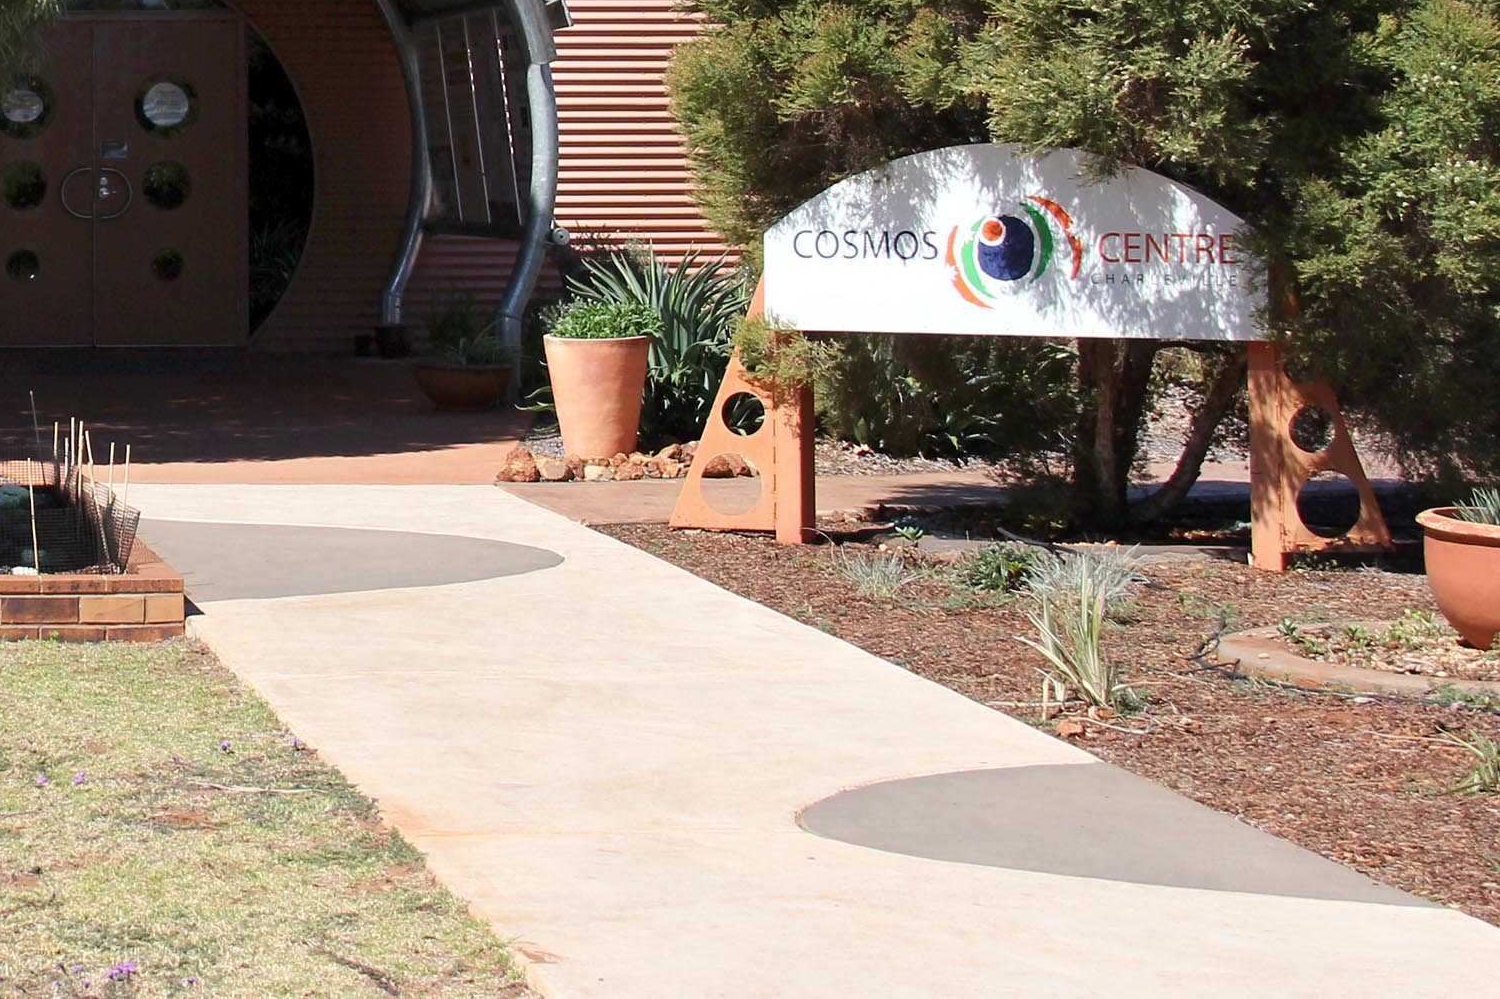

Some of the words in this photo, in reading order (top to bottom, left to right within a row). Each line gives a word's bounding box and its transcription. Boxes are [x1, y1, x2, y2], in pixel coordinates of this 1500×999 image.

[793, 230, 938, 260] COSMOS
[1099, 232, 1238, 264] CENTRE
[1091, 273, 1238, 287] CHARLEVILLE
